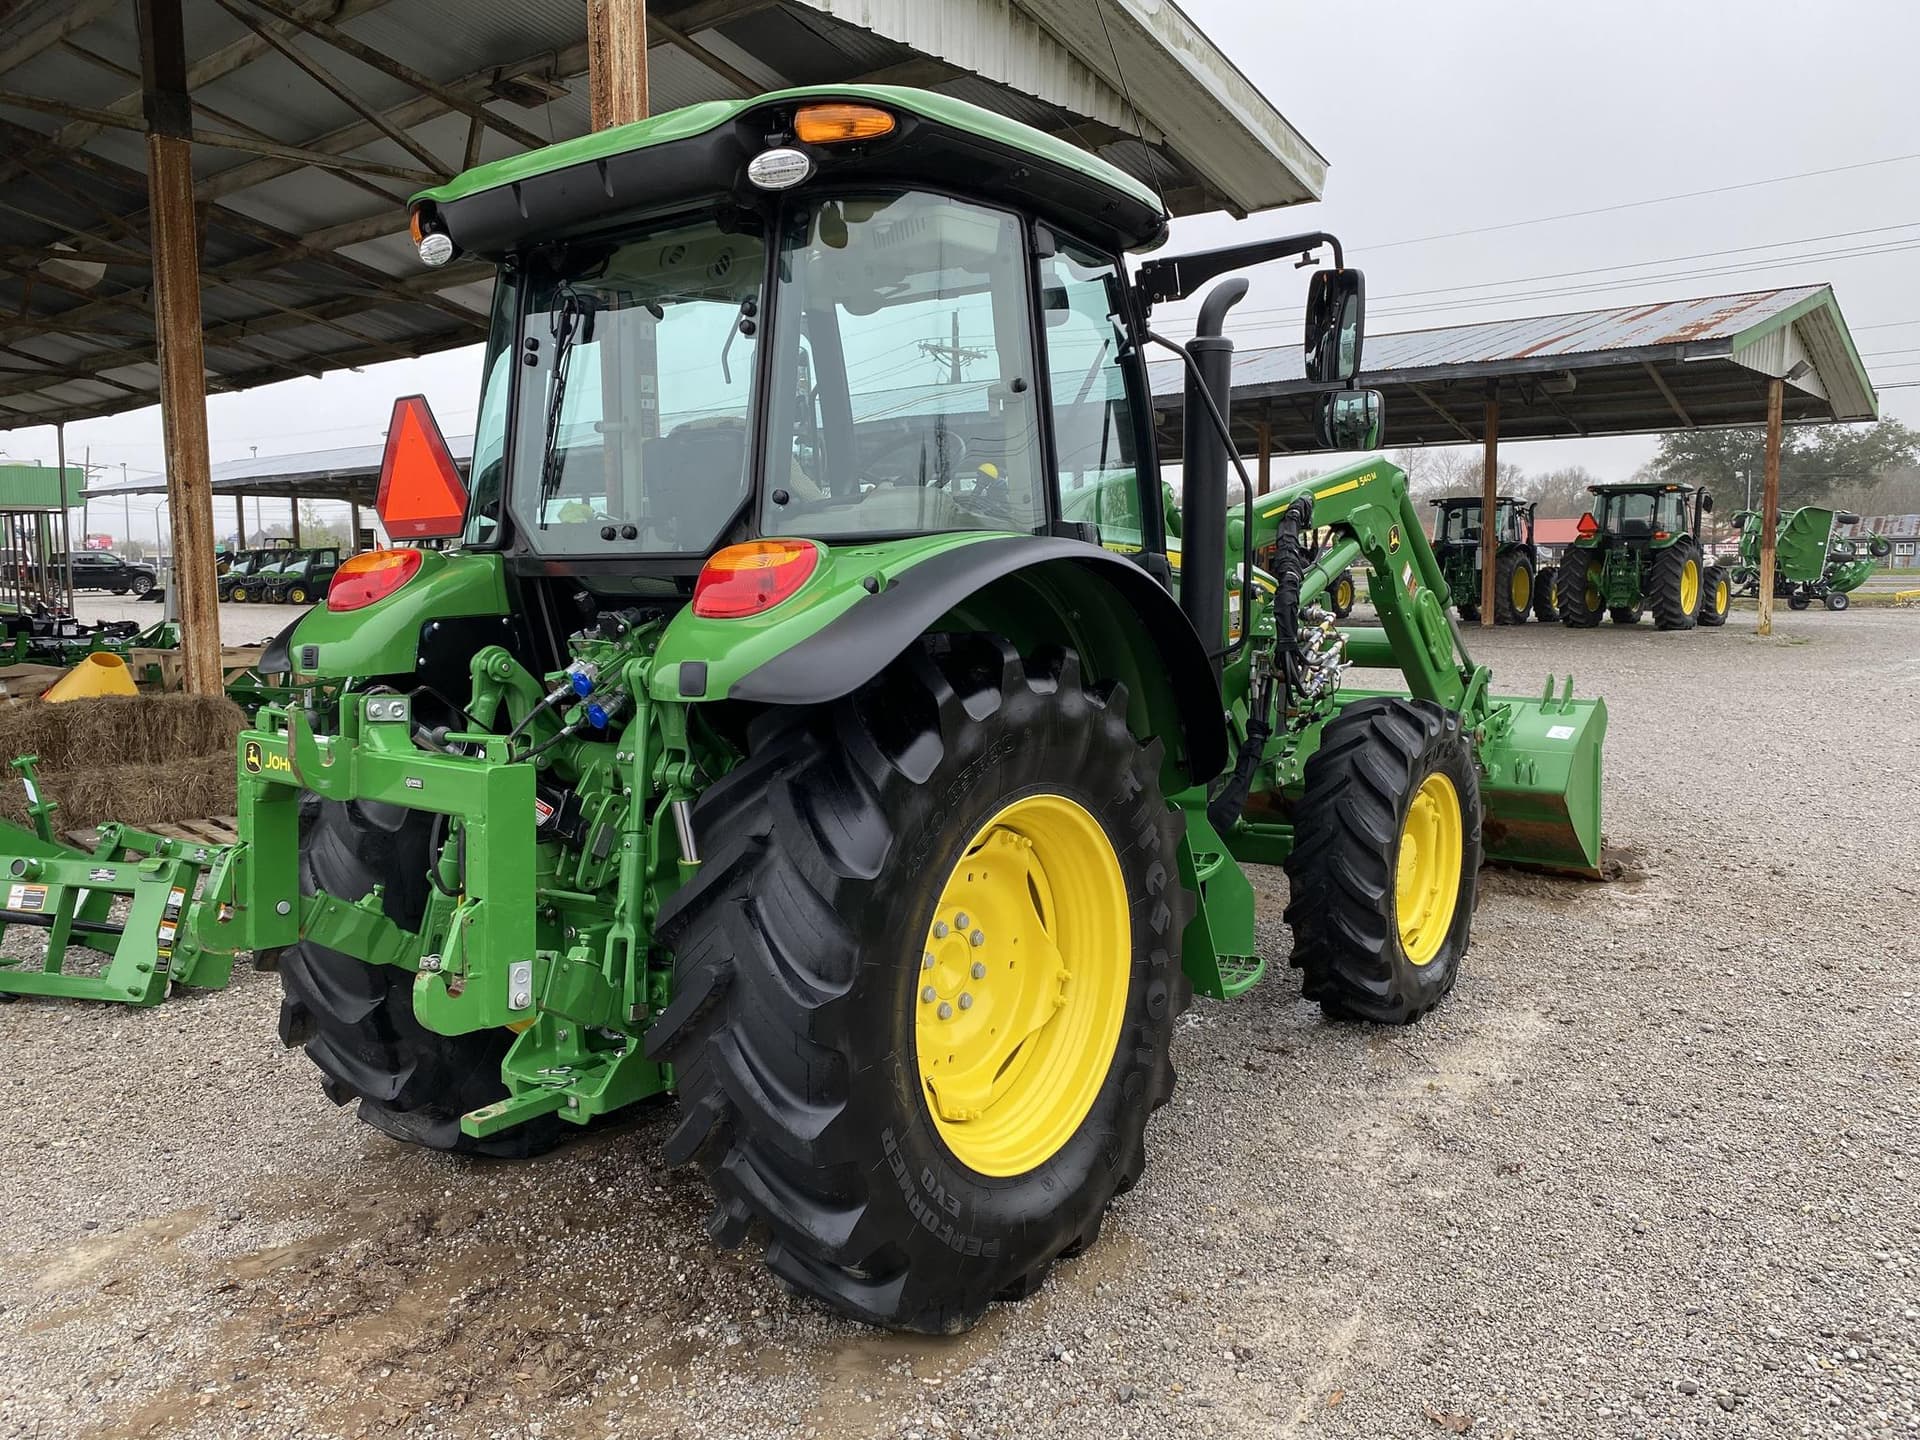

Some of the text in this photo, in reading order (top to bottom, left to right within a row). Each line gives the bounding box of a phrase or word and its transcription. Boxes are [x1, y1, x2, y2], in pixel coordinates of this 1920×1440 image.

[265, 751, 290, 772] JOH
[881, 1127, 1000, 1258] PERFORMER
[920, 1167, 961, 1219] EVO
